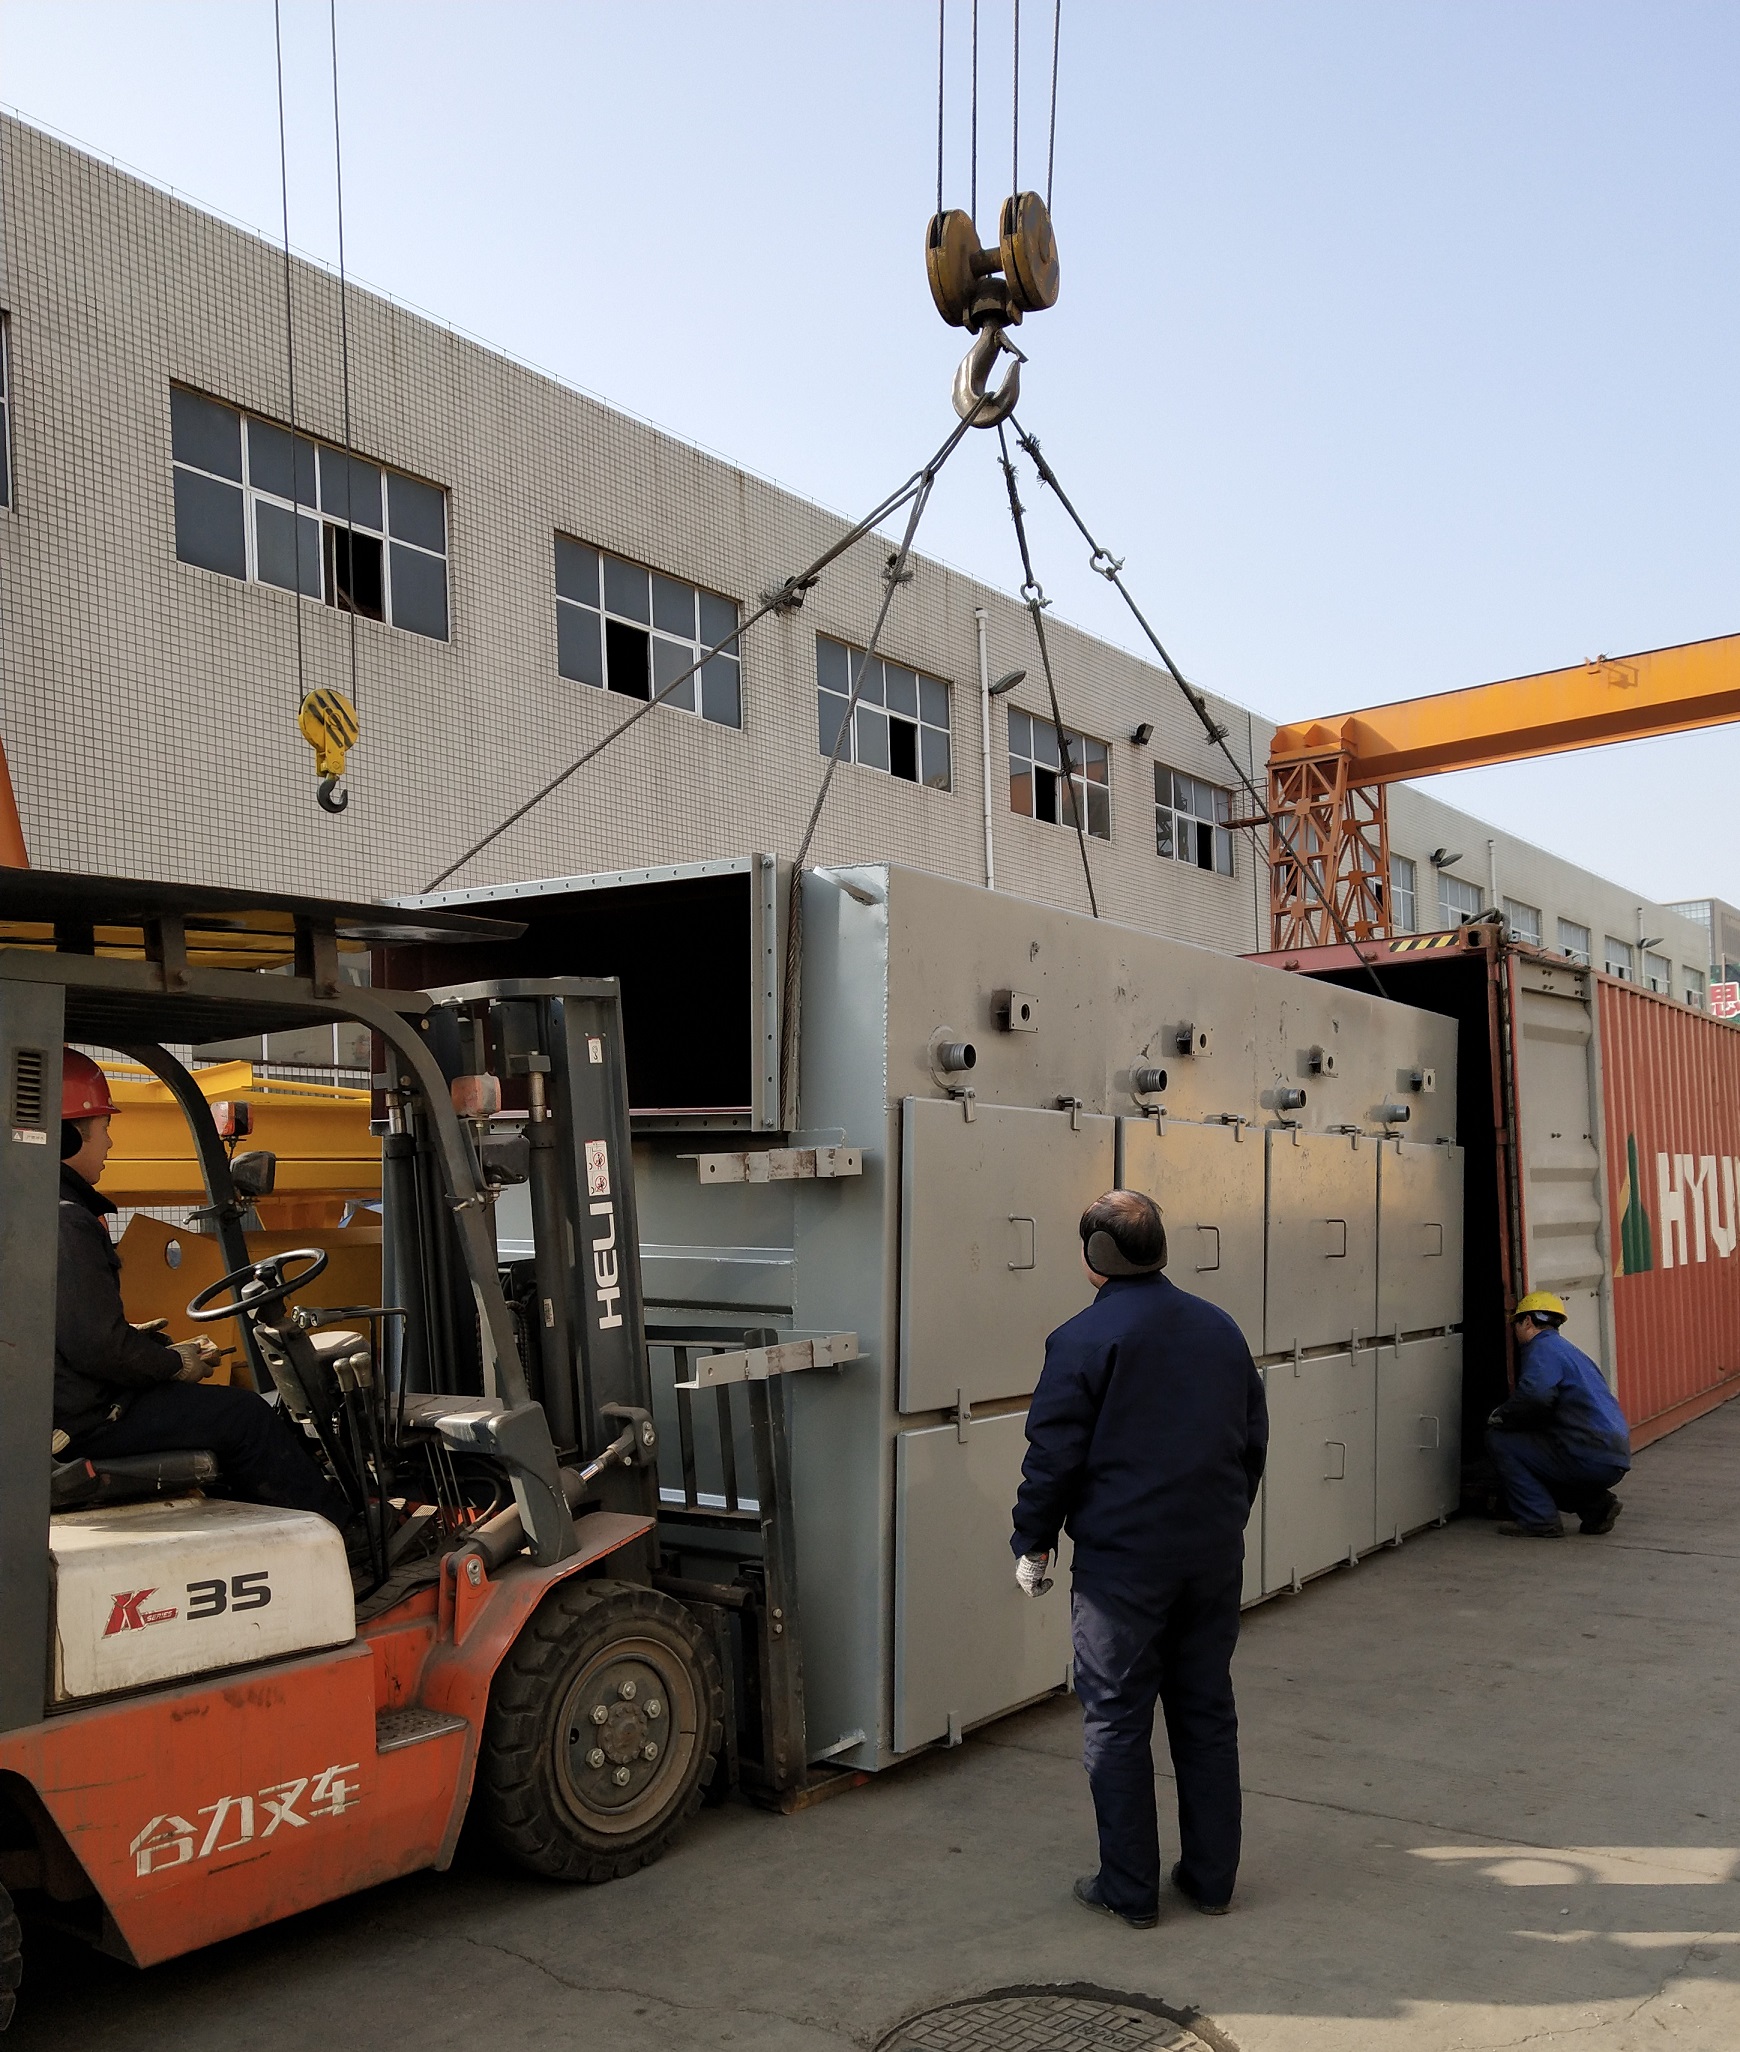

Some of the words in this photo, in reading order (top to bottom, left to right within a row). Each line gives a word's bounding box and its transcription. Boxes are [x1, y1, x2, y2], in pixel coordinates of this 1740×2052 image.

[589, 1201, 623, 1330] HELI
[1657, 1152, 1740, 1269] HYU
[102, 1587, 158, 1638] K
[145, 1610, 174, 1622] SERIES
[186, 1571, 272, 1621] 35
[129, 1763, 360, 1878] 合力叉车
